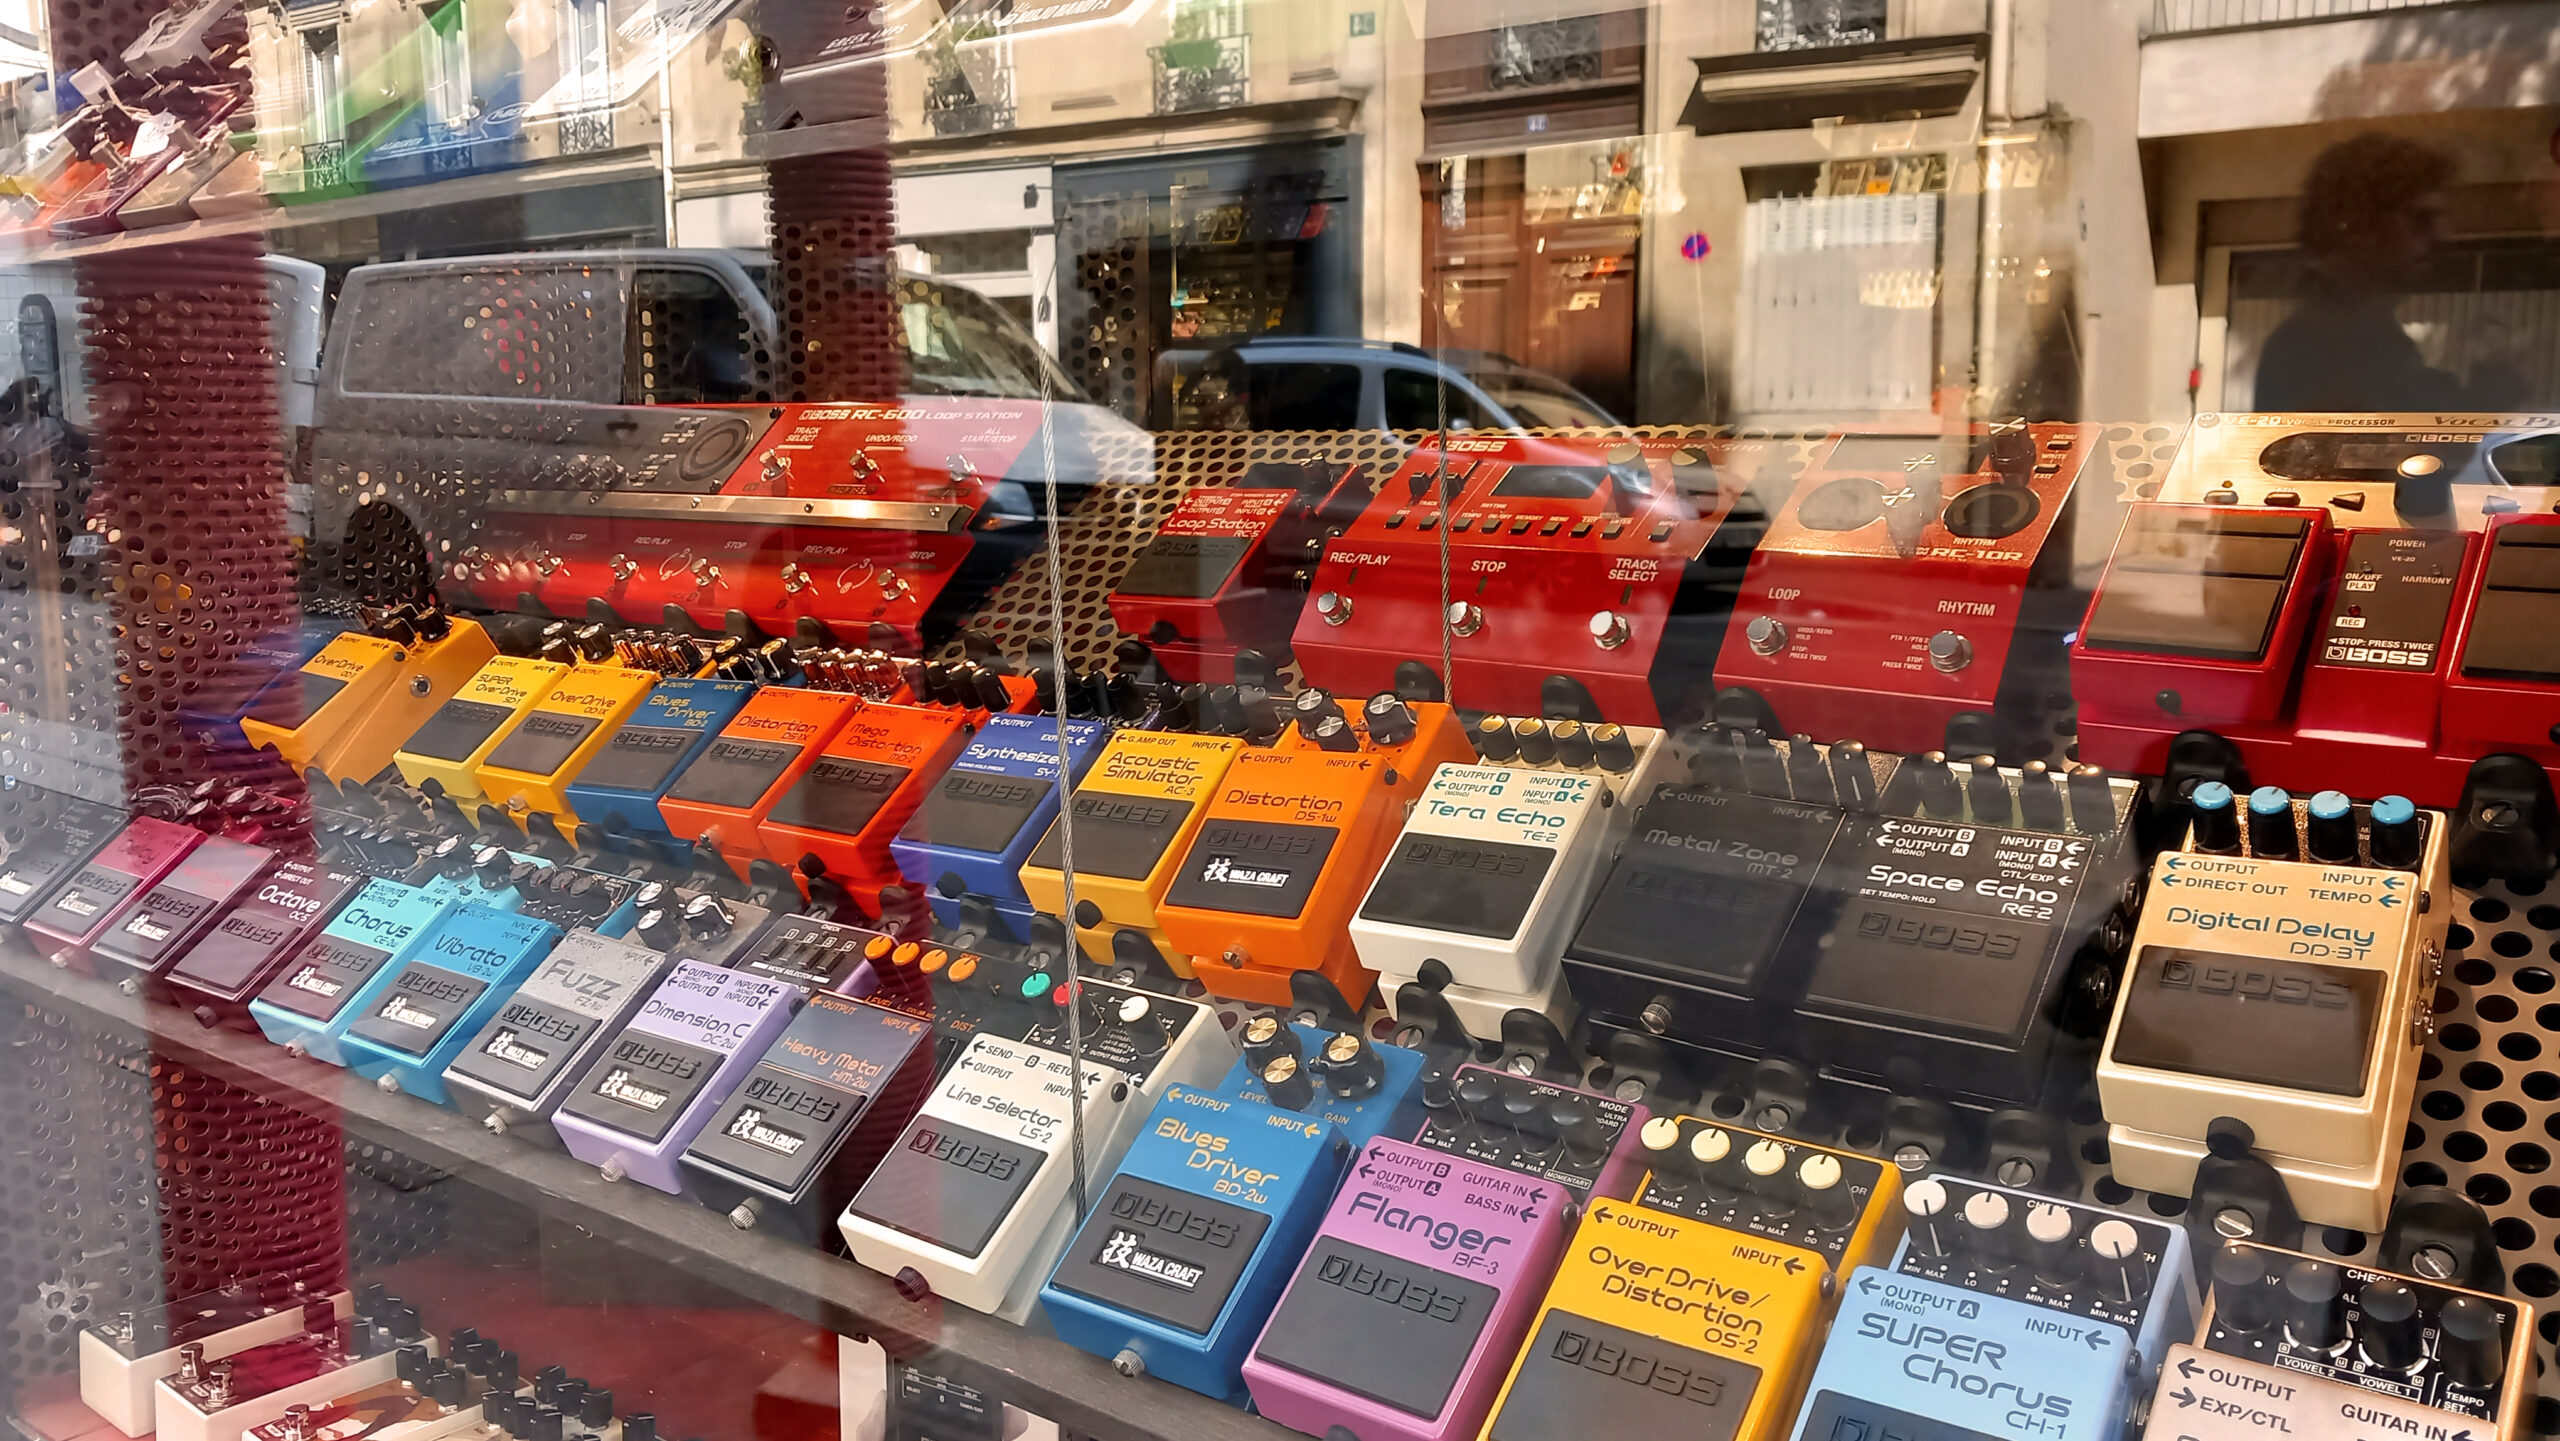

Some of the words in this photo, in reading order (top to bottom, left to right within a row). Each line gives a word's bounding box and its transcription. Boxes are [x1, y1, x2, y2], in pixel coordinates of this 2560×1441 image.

[809, 409, 851, 420] BOSS
[850, 409, 926, 420] RC-600
[926, 412, 961, 420] LOOP
[963, 412, 1023, 420] STATION
[2327, 417, 2396, 427] PROCESSOR
[865, 434, 918, 442] UNDO/REDO
[960, 435, 1017, 443] START/STOP
[1446, 440, 1507, 452] BOSS
[2421, 433, 2485, 443] BOSS
[1167, 517, 1206, 530] Loop
[1207, 517, 1267, 530] Station
[567, 533, 588, 541] STOP
[1233, 529, 1261, 538] RC-5
[724, 541, 747, 550] STOP
[1953, 538, 1997, 546] RHYTHM
[2389, 540, 2426, 548] POWER
[909, 550, 936, 560] STOP
[1329, 552, 1390, 566] REC/PLAY
[1929, 548, 2023, 561] RC-10R
[1471, 560, 1507, 573] STOP
[1616, 558, 1658, 570] TRACK
[1608, 569, 1659, 582] SELECT
[2345, 572, 2383, 581] ON/OFF
[2401, 575, 2452, 585] HARMONY
[2349, 581, 2375, 590] PLAY
[1768, 588, 1800, 600] LOOP
[1937, 600, 1996, 617] RHYTHM
[2338, 637, 2366, 647] STOP:
[2368, 639, 2401, 649] PRESS
[2403, 641, 2435, 652] TWICE
[2346, 647, 2429, 667] BOSS
[476, 673, 514, 686] SUPER
[648, 694, 690, 708] Blues
[664, 705, 717, 720] Driver
[736, 714, 818, 733] Distortion
[850, 722, 890, 737] Mega
[1000, 718, 1034, 728] OUTPUT
[846, 735, 922, 755] Distortion
[1192, 741, 1220, 750] INPUT
[1107, 751, 1200, 771] Acoustic
[1254, 754, 1294, 764] OUTPUT
[1326, 759, 1358, 769] INPUT
[1103, 765, 1203, 785] Simulator
[1455, 769, 1497, 780] OUTPUT
[1164, 785, 1195, 796] AC-3
[1522, 789, 1556, 799] INPUT
[1224, 789, 1343, 812] Distortion
[1677, 791, 1728, 807] OUTPUT
[1294, 810, 1337, 823] DS-1w
[1428, 799, 1486, 820] Tera
[1496, 807, 1566, 828] Echo
[1772, 806, 1814, 819] INPUT
[1522, 829, 1559, 842] TE-2
[1902, 824, 1956, 838] OUTPUT
[1644, 829, 1720, 853] Metal
[1727, 841, 1799, 866] Zone
[1895, 838, 1951, 853] OUTPUT
[2001, 835, 2044, 849] INPUT
[1892, 847, 1926, 857] (MONO)
[1995, 850, 2038, 863] INPUT
[1747, 862, 1793, 880] MT-2
[2190, 860, 2259, 875] OUTPUT
[1867, 864, 1965, 891] Space
[1976, 879, 2058, 904] Echo
[2001, 870, 2055, 883] CTL/EXP
[2322, 872, 2377, 887] INPUT
[2185, 877, 2251, 894] DIRECT
[2252, 882, 2288, 896] OUT
[258, 884, 322, 912] Octave
[1860, 888, 1877, 896] SET
[1878, 890, 1910, 900] TEMPO:
[1912, 894, 1936, 904] HOLD
[2309, 889, 2373, 904] TEMPO
[2001, 902, 2053, 919] RE-2
[344, 908, 413, 939] Chorus
[2166, 906, 2269, 933] Digital
[2275, 917, 2375, 947] Delay
[435, 933, 507, 967] Vibrato
[2290, 942, 2371, 962] DD-3T
[467, 963, 495, 977] VB-2w
[2200, 966, 2352, 1010] BOSS
[823, 1000, 857, 1016] OUTPUT
[644, 999, 730, 1034] Dimension
[732, 1023, 752, 1038] C
[881, 1016, 909, 1030] INPUT
[780, 1036, 834, 1065] Heavy
[834, 1052, 884, 1077] Metal
[972, 1062, 1014, 1081] OUTPUT
[600, 1069, 629, 1097] 技
[946, 1083, 983, 1106] Line
[981, 1094, 1063, 1128] Selector
[1185, 1092, 1231, 1113] OUTPUT
[1599, 1101, 1629, 1114] MODE
[1266, 1114, 1303, 1133] INPUT
[1018, 1124, 1053, 1144] LS-2
[1155, 1117, 1230, 1153] Blues
[1186, 1148, 1280, 1187] Driver
[1386, 1151, 1436, 1173] OUTPUT
[1376, 1169, 1426, 1191] OUTPUT
[1463, 1171, 1510, 1193] GUITAR
[1512, 1183, 1528, 1198] IN
[1212, 1179, 1268, 1205] BD-2w
[1464, 1193, 1506, 1212] BASS
[1505, 1203, 1519, 1217] IN
[1696, 1207, 1708, 1217] LO
[1134, 1196, 1241, 1249] BOSS
[1347, 1191, 1511, 1254] Flanger
[1617, 1214, 1680, 1240] OUTPUT
[1804, 1235, 1818, 1245] OD
[1828, 1241, 1842, 1251] DS
[1102, 1230, 1137, 1269] 技
[1732, 1244, 1782, 1268] INPUT
[1133, 1249, 1166, 1274] WAZA
[1163, 1261, 1204, 1284] CRAFT
[1452, 1252, 1499, 1276] BF-3
[1963, 1278, 1978, 1287] LO
[1343, 1262, 1466, 1324] BOSS
[1885, 1285, 1956, 1312] OUTPUT
[1602, 1274, 1763, 1335] Distortion
[1880, 1297, 1925, 1318] (MONO)
[2025, 1317, 2083, 1342] INPUT
[1704, 1327, 1758, 1354] OS-2
[1857, 1312, 2007, 1371] SUPER
[1903, 1353, 2072, 1419] Chorus
[2208, 1367, 2297, 1402] OUTPUT
[2446, 1391, 2485, 1407] TEMPO
[2199, 1398, 2293, 1434] EXP/CTL
[2341, 1403, 2419, 1437] GUITAR
[2424, 1423, 2448, 1441] IN
[2005, 1410, 2066, 1439] CH-1
